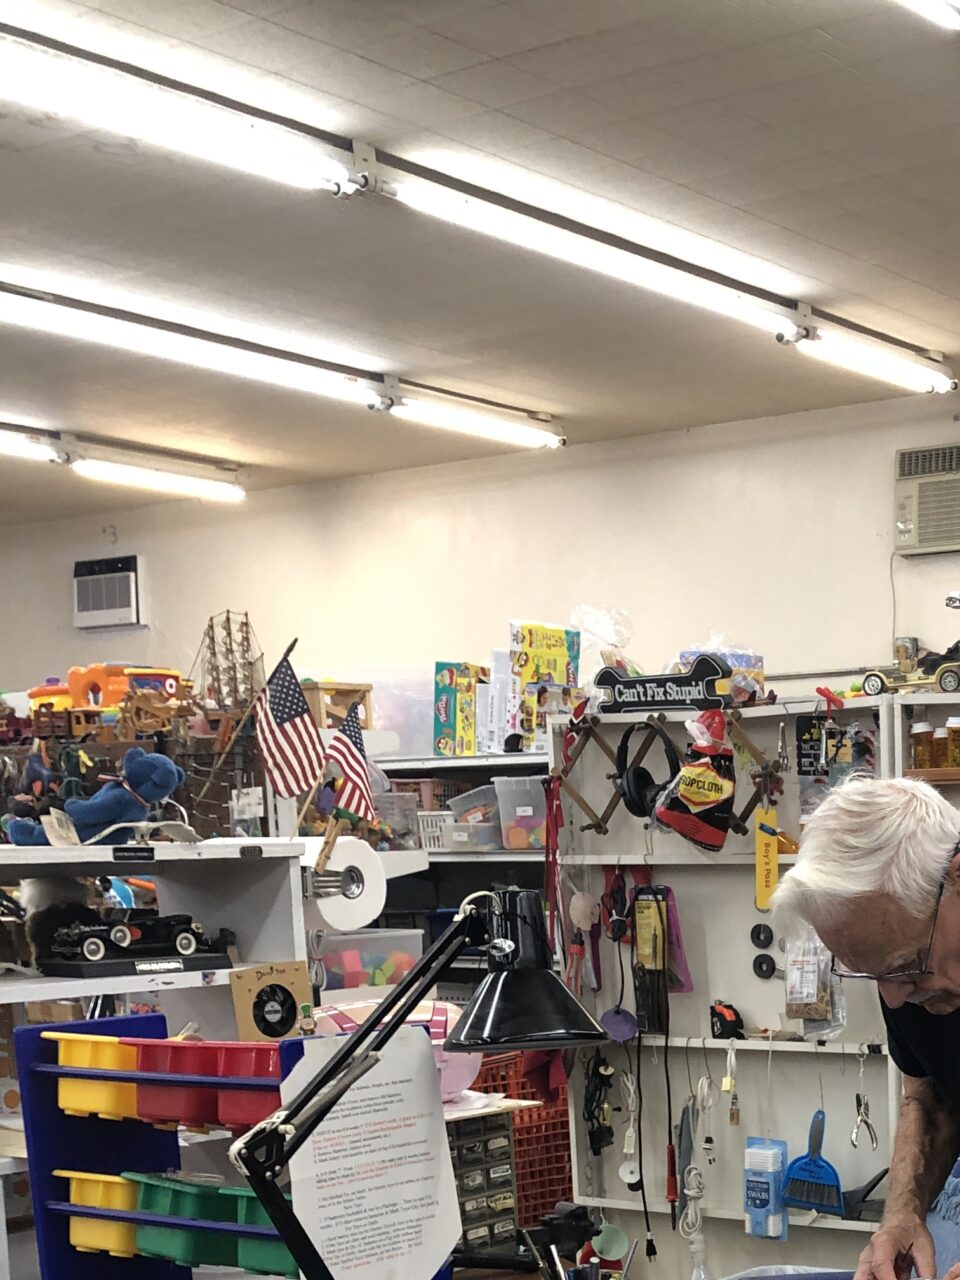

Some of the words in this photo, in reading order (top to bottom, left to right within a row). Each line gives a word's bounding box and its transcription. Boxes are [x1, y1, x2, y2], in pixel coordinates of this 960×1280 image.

[615, 684, 646, 702] Can't
[646, 683, 667, 701] Fix
[667, 681, 705, 704] Stupid
[747, 1191, 769, 1200] SWABS
